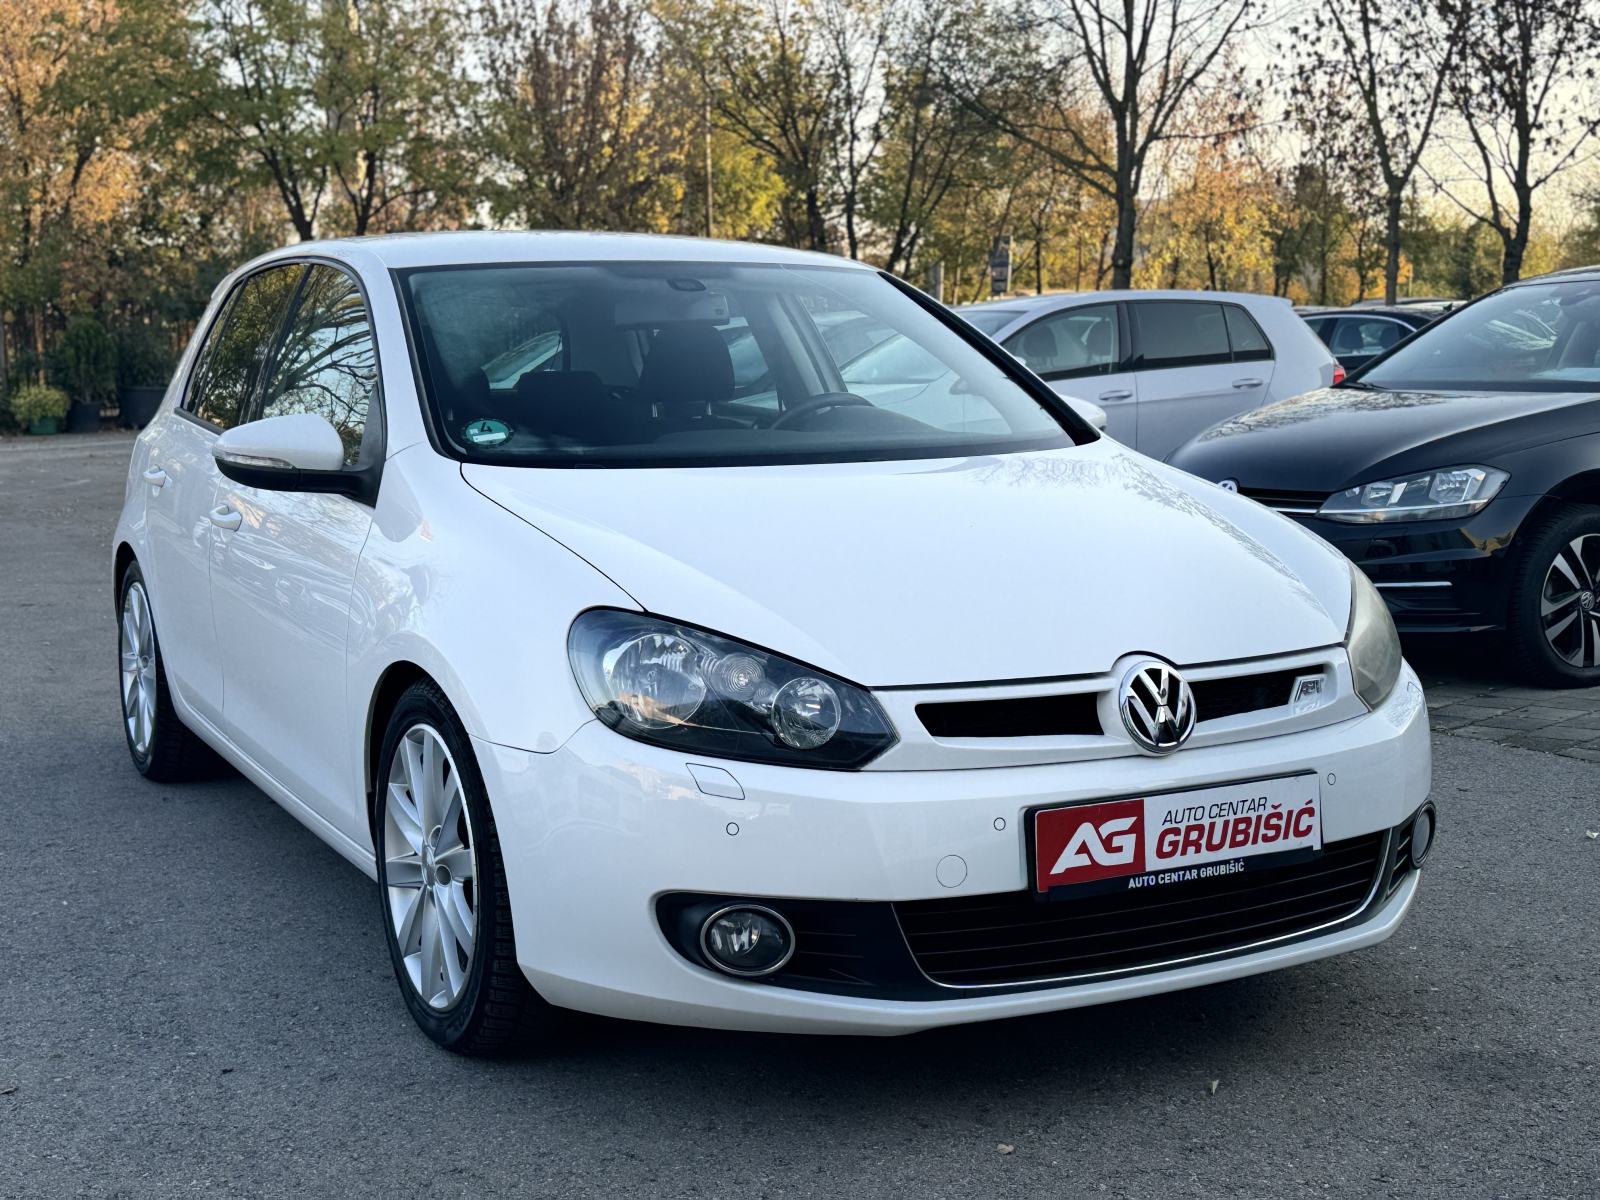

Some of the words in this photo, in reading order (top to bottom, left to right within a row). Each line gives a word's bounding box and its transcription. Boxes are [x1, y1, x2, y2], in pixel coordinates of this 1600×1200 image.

[1155, 798, 1316, 860] GRUBIŠIĆ
[1162, 805, 1205, 826] AUTO
[1208, 796, 1268, 819] CENTAR
[1050, 816, 1138, 875] AG
[1128, 875, 1156, 889] AUTO
[1158, 869, 1198, 884] CENTAR
[1200, 858, 1245, 878] GRUBIŠIĆ
